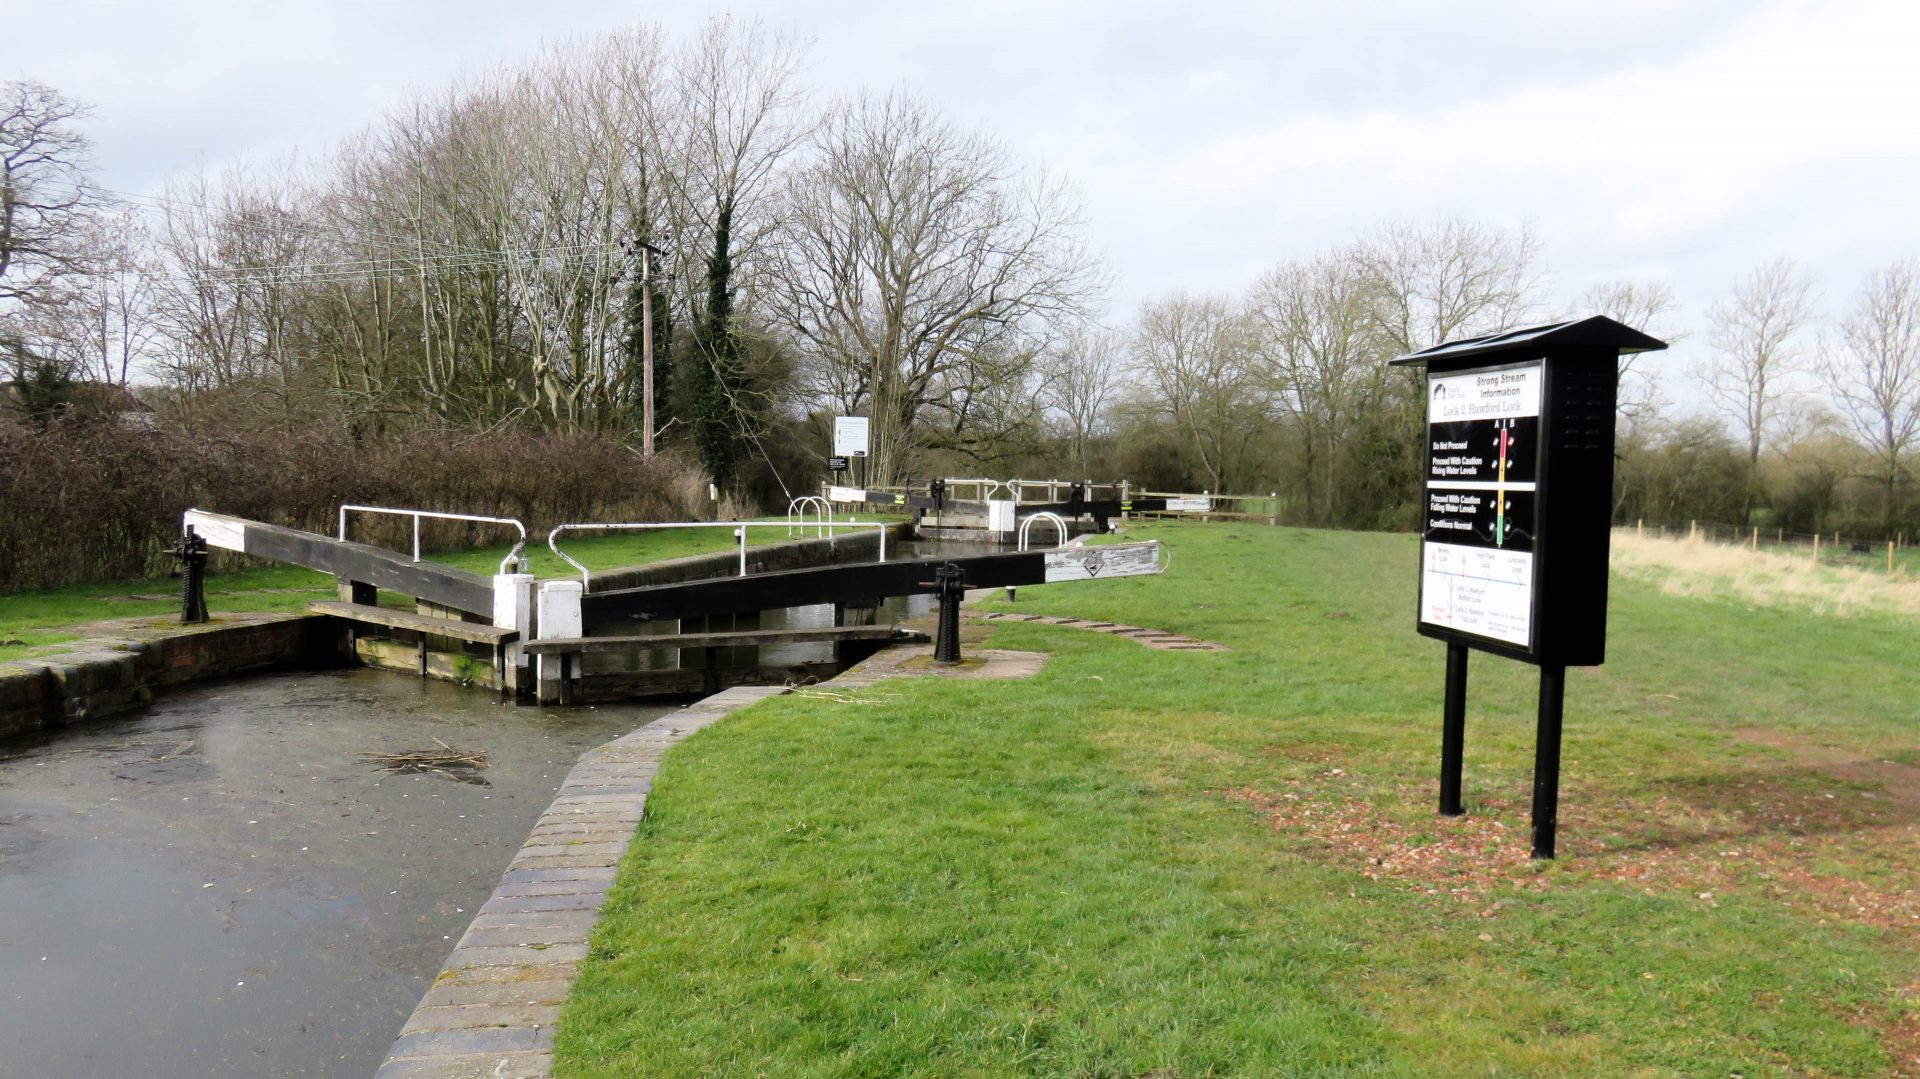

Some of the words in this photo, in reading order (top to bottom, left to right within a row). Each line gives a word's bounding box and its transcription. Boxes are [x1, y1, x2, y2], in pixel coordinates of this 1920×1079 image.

[1477, 376, 1498, 386] Strong
[1500, 373, 1526, 384] Stream
[1480, 388, 1520, 398] Information
[1443, 405, 1459, 416] Lock
[1468, 400, 1500, 414] Hawford
[1503, 400, 1522, 412] Lock
[1494, 420, 1499, 428] A
[1510, 418, 1514, 428] B
[1432, 442, 1439, 450] Do
[1448, 441, 1468, 450] Proceed
[1432, 456, 1450, 465] Proceed
[1450, 456, 1461, 465] With
[1462, 456, 1483, 466] Caution
[1432, 466, 1446, 476] Rising
[1446, 466, 1459, 474] Water
[1460, 466, 1477, 475] Levels
[1430, 494, 1448, 503] Proceed
[1449, 494, 1459, 503] With
[1460, 495, 1480, 504] Caution
[1430, 503, 1445, 514] Falling
[1445, 504, 1459, 512] Water
[1460, 504, 1476, 514] Levels
[1430, 519, 1453, 529] Conditions
[1454, 521, 1472, 531] Normal
